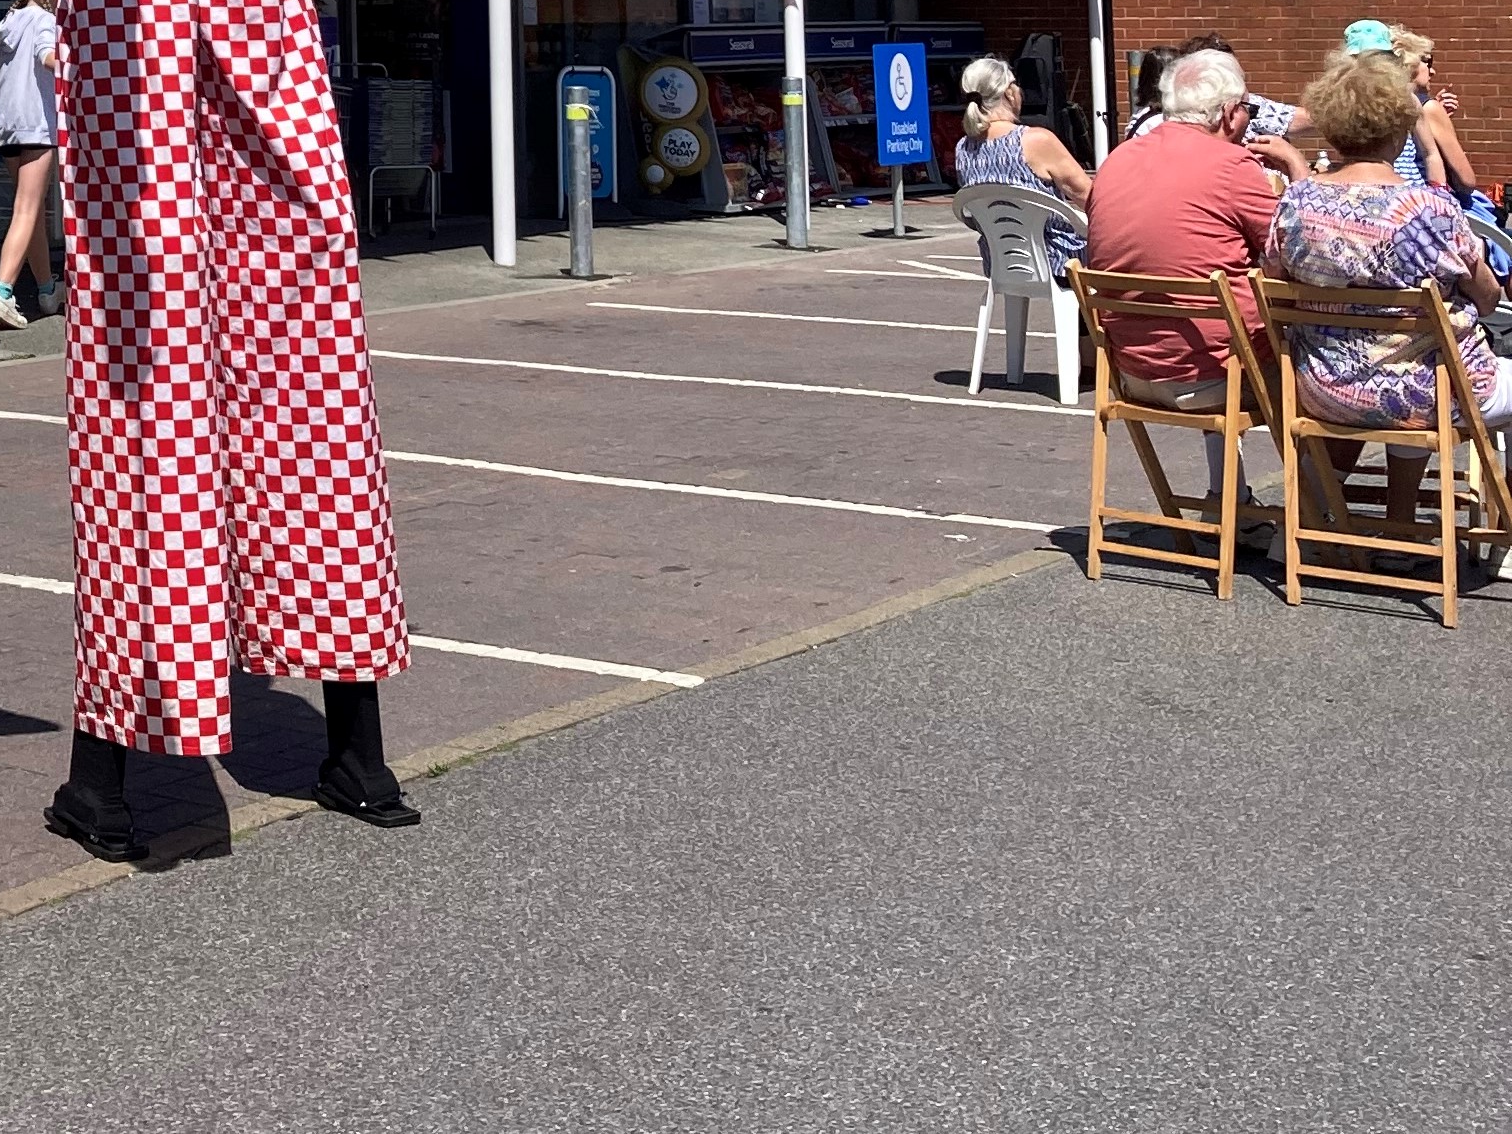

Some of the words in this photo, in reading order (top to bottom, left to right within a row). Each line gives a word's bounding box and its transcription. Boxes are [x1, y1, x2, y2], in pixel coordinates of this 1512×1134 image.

[891, 120, 918, 136] Disabled
[663, 144, 697, 158] TODAY
[668, 137, 693, 150] PLAY
[886, 138, 910, 156] Parking
[909, 137, 923, 154] Only
